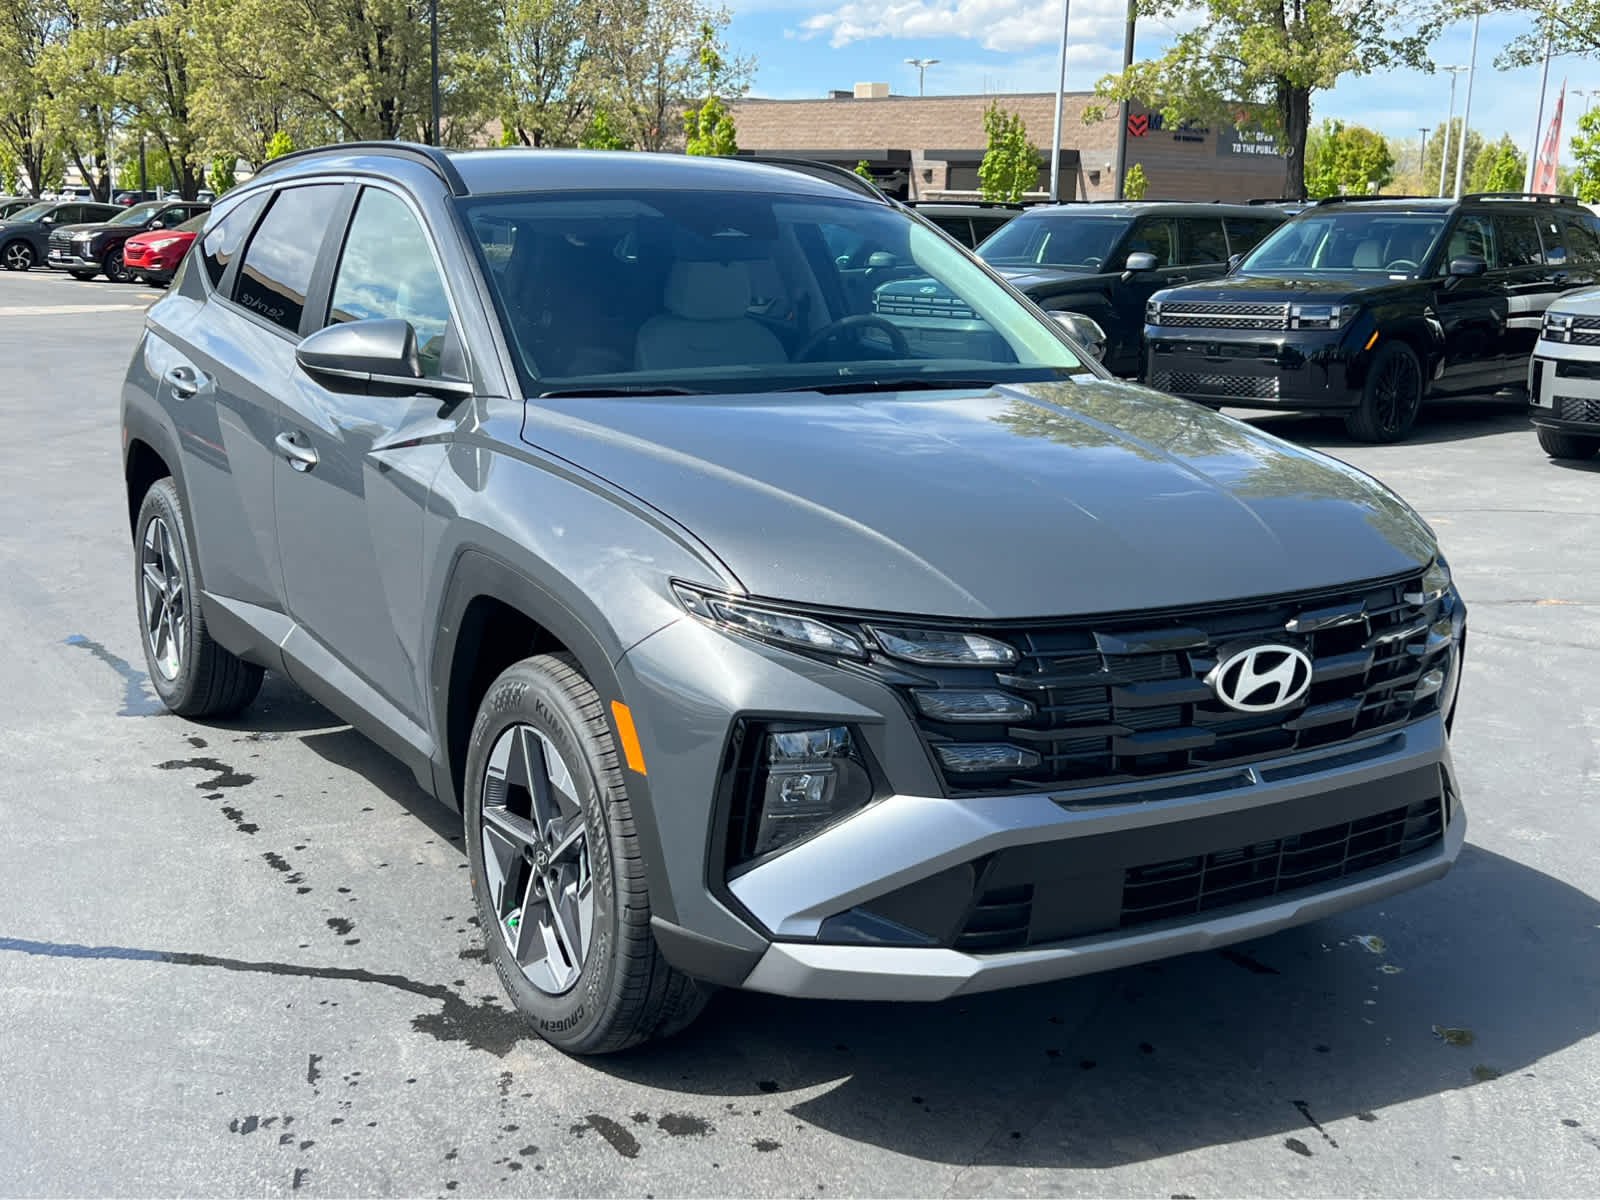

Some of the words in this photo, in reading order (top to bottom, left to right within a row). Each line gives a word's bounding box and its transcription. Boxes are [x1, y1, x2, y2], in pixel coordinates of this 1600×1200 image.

[1232, 143, 1242, 153] TO
[1242, 143, 1255, 154] THE
[1255, 144, 1279, 155] PUBLIC
